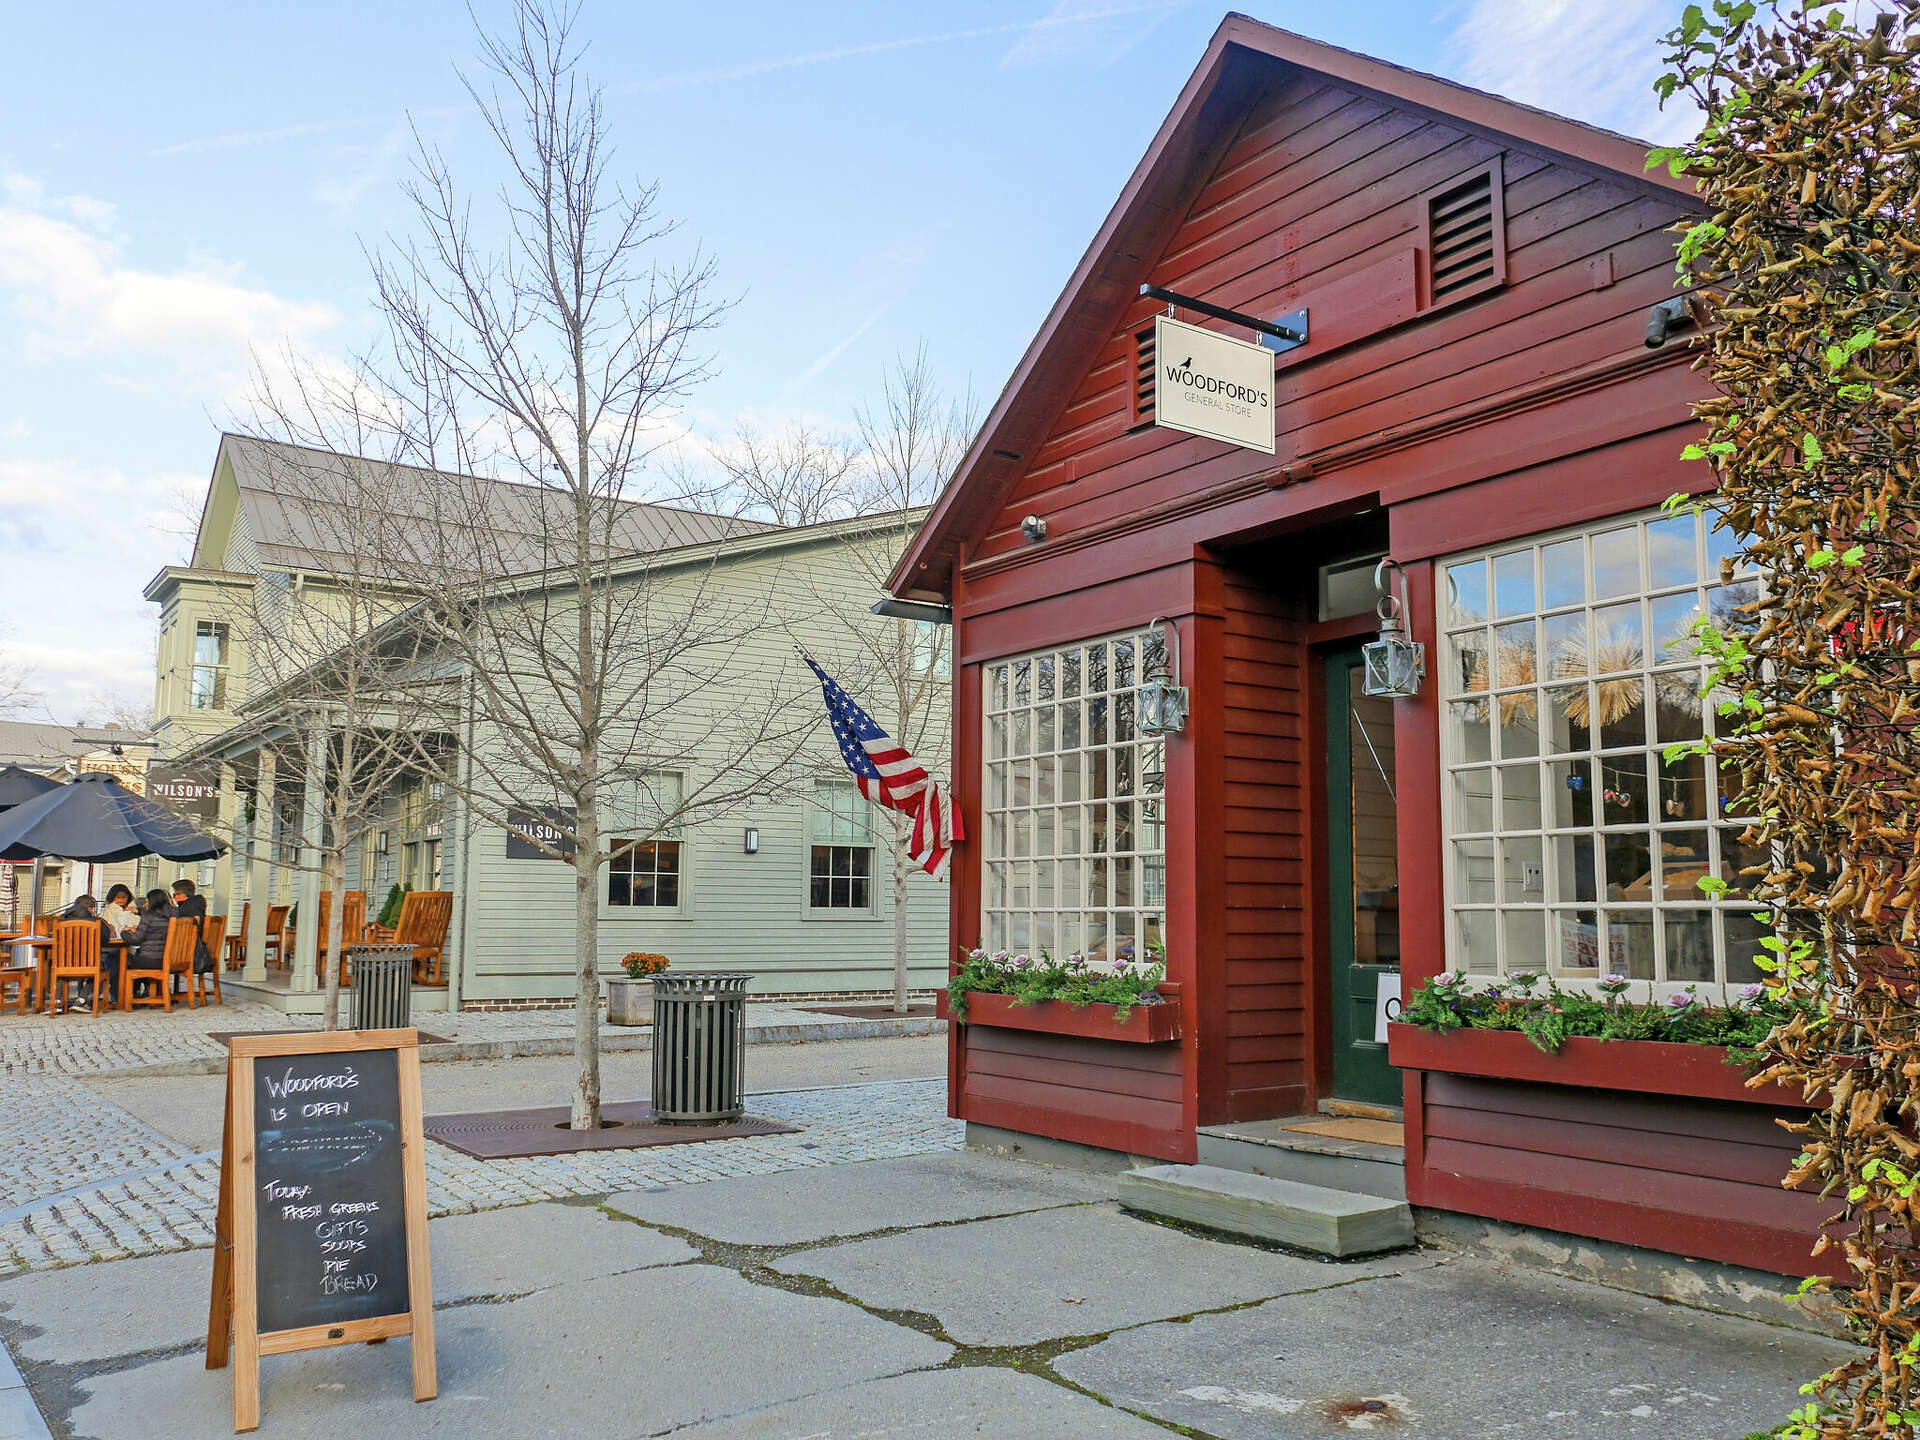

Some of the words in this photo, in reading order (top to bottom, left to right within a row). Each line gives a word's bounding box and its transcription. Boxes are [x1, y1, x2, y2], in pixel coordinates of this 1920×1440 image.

[1166, 365, 1268, 408] WOODFORD'S
[1184, 391, 1223, 411] GENERAL
[1225, 402, 1252, 418] STORE
[152, 783, 214, 798] WILSON'S
[302, 1101, 348, 1118] OPEN
[282, 1203, 322, 1220] FRESH
[329, 1201, 380, 1215] GREENS
[320, 1240, 367, 1254] SOUPS
[320, 1273, 378, 1295] BREAD
